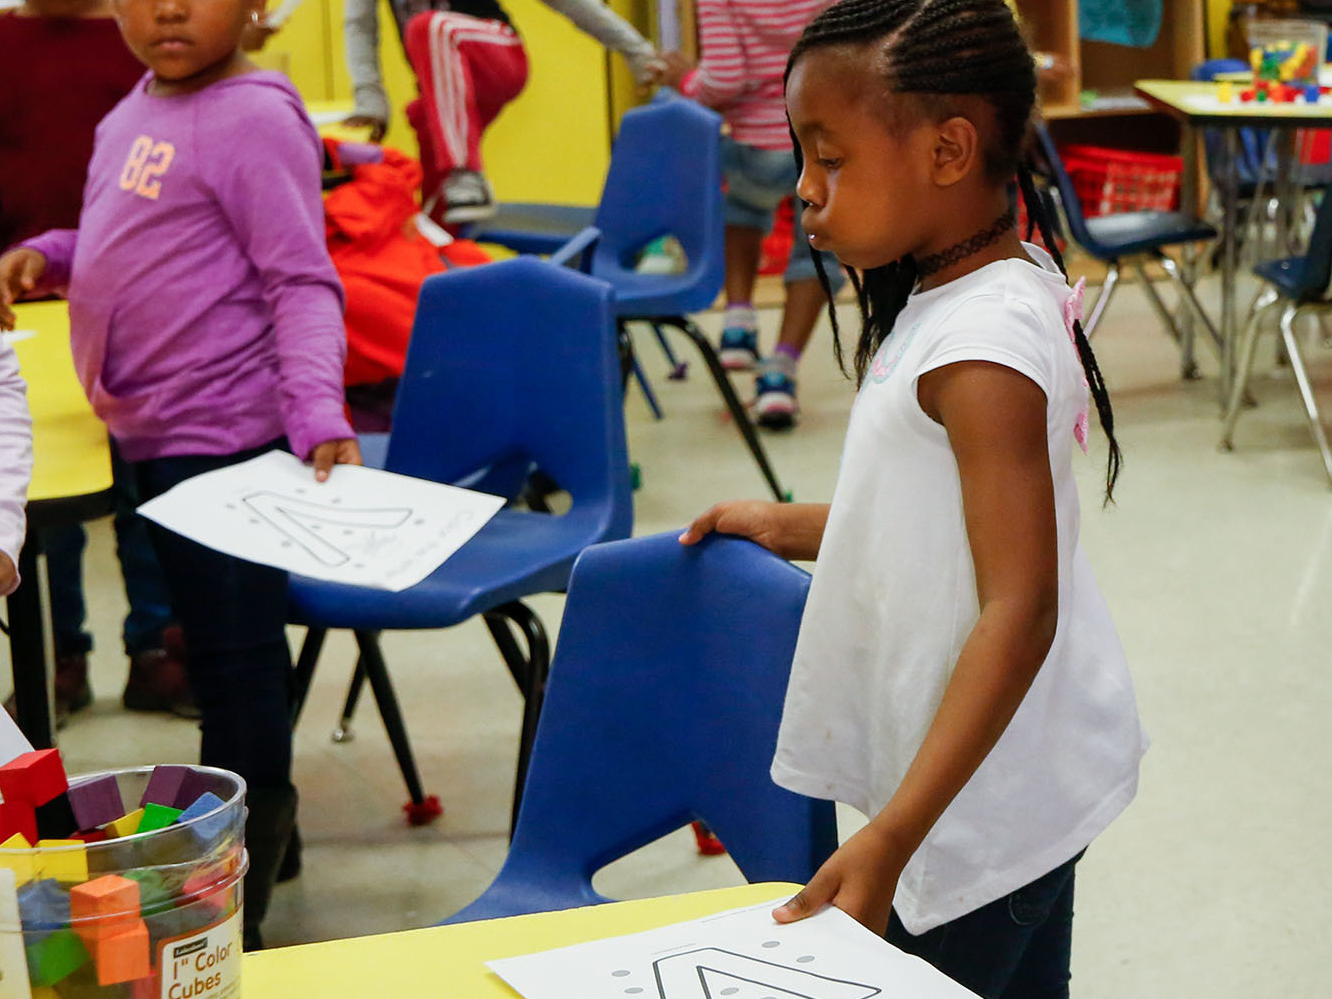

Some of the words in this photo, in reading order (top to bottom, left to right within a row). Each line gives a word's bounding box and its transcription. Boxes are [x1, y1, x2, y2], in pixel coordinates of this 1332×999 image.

[119, 134, 175, 199] 82
[195, 941, 233, 972] Color
[168, 971, 222, 999] Cubes
